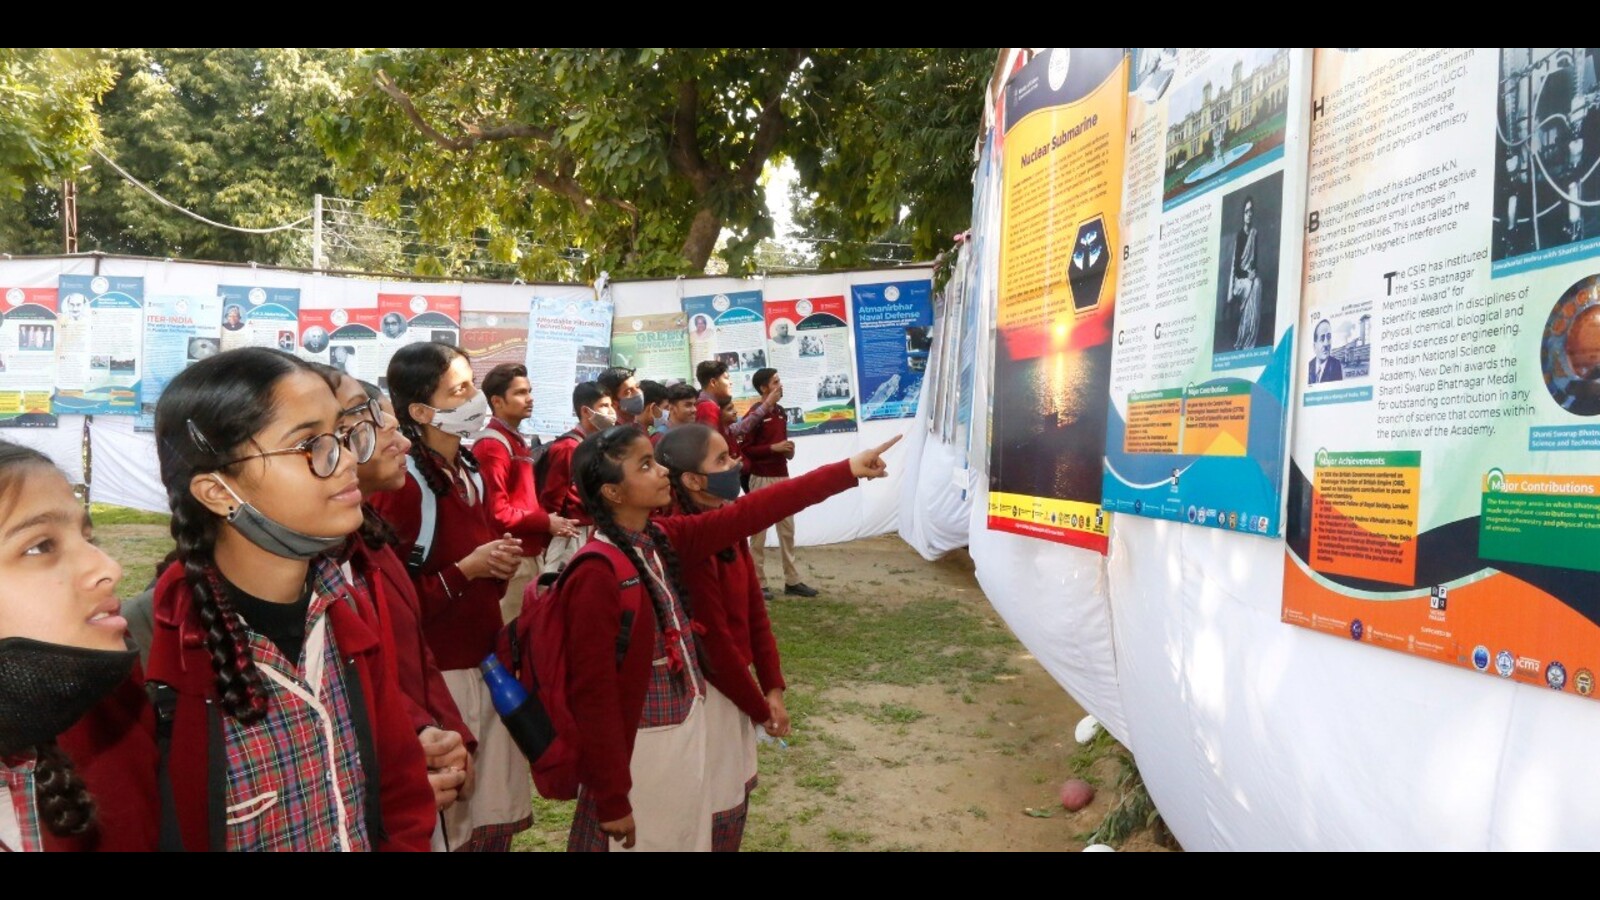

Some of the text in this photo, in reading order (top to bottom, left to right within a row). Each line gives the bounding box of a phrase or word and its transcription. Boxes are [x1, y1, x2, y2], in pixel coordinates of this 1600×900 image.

[1432, 48, 1474, 74] Chairman
[1387, 105, 1410, 123] which
[1412, 87, 1456, 112] Bhatnagar
[1390, 80, 1438, 108] Commission
[1366, 118, 1416, 145] contributions
[1418, 109, 1438, 123] were
[1440, 102, 1454, 114] the
[1426, 111, 1468, 135] chemistry
[1021, 114, 1098, 168] Nuclear Submarine
[1368, 187, 1382, 198] one
[1404, 166, 1440, 185] students
[1376, 197, 1390, 208] one
[1391, 192, 1400, 203] of
[1400, 189, 1414, 200] the
[1416, 180, 1438, 195] most
[1438, 169, 1476, 188] sensitive
[1357, 212, 1388, 228] measure
[1388, 203, 1410, 218] small
[1410, 193, 1446, 211] changes
[1448, 189, 1456, 199] in
[1393, 219, 1408, 232] This
[1410, 215, 1426, 226] was
[1427, 205, 1452, 221] called
[1454, 201, 1470, 213] the
[1370, 235, 1406, 253] Magnetic
[1407, 220, 1458, 242] Interference
[1407, 262, 1426, 276] CSIR
[1428, 260, 1444, 271] has
[1445, 248, 1488, 267] instituted
[1395, 283, 1409, 294] the
[1428, 268, 1474, 286] Bhatnagar
[859, 303, 913, 314] Atmanirbhar
[1382, 293, 1420, 309] Memorial
[1452, 285, 1464, 295] for
[1382, 286, 1530, 325] scientific research in disciplines of
[147, 315, 193, 324] ITER-INDIA
[884, 312, 920, 320] Defense
[1457, 307, 1502, 325] biological
[1504, 303, 1524, 317] and
[536, 322, 576, 331] Technology
[636, 332, 684, 342] GREEN
[1380, 323, 1522, 352] medical sciences or engineering.
[1380, 344, 1496, 366] The Indian National Science
[1418, 364, 1438, 376] New
[1439, 360, 1462, 373] Delhi
[1464, 357, 1498, 371] awards
[1500, 355, 1517, 367] the
[1378, 372, 1517, 395] Shanti Swarup Bhatnagar Medal
[1378, 388, 1530, 409] for outstanding contribution in any
[1377, 404, 1536, 423] branch of science that comes within
[1376, 423, 1496, 441] the purview of the Academy.
[1320, 456, 1385, 468] Major Achievements
[1492, 480, 1594, 494] Major Contributions
